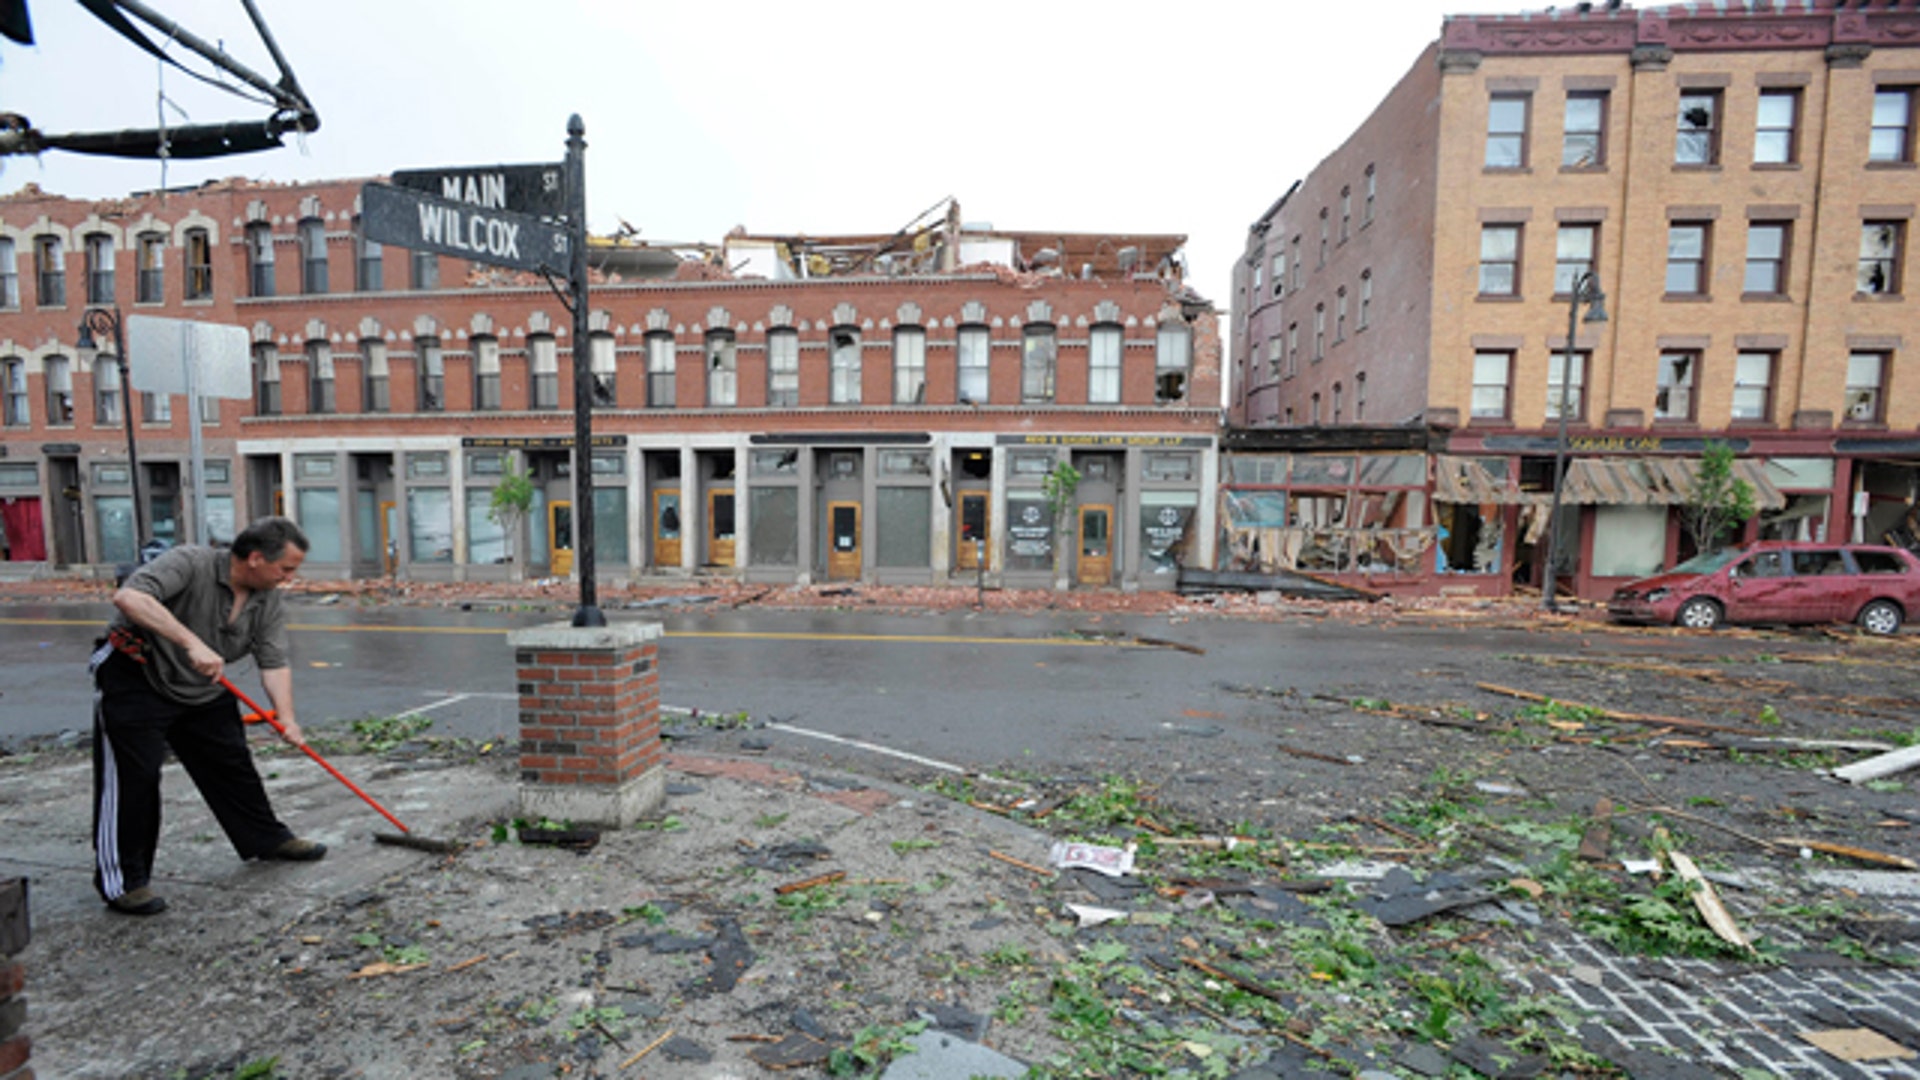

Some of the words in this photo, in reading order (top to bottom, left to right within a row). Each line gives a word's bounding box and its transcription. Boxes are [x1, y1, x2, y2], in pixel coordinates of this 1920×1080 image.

[442, 173, 506, 210] MAIN
[542, 171, 559, 192] ST
[418, 203, 521, 260] WILCOX
[553, 233, 568, 253] ST
